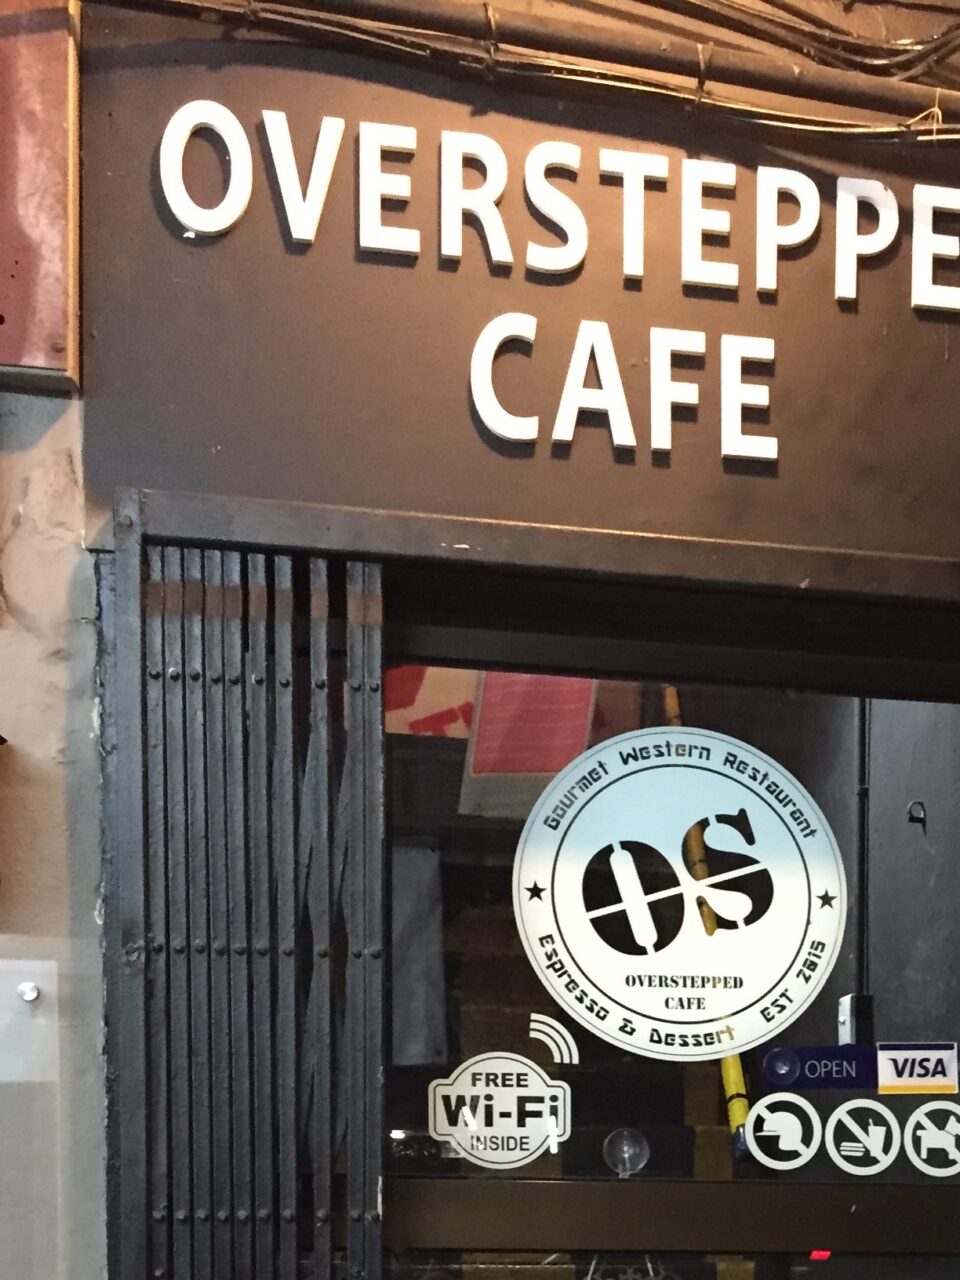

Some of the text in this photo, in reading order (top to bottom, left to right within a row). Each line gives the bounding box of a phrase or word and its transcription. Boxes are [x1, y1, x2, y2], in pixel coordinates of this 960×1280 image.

[471, 312, 780, 461] CAFE
[543, 741, 818, 839] Gourmet Western Restaurant
[582, 808, 774, 955] OS
[538, 934, 610, 1021] Espresso
[649, 1025, 735, 1047] Dessert
[625, 974, 744, 989] OVERSTEPPED
[664, 997, 706, 1010] CAFE
[760, 988, 794, 1023] EST
[471, 1072, 529, 1088] FREE
[804, 1057, 947, 1078] OPEN VISA
[441, 1093, 559, 1128] Wi-Fi
[470, 1135, 530, 1151] INSIDE
